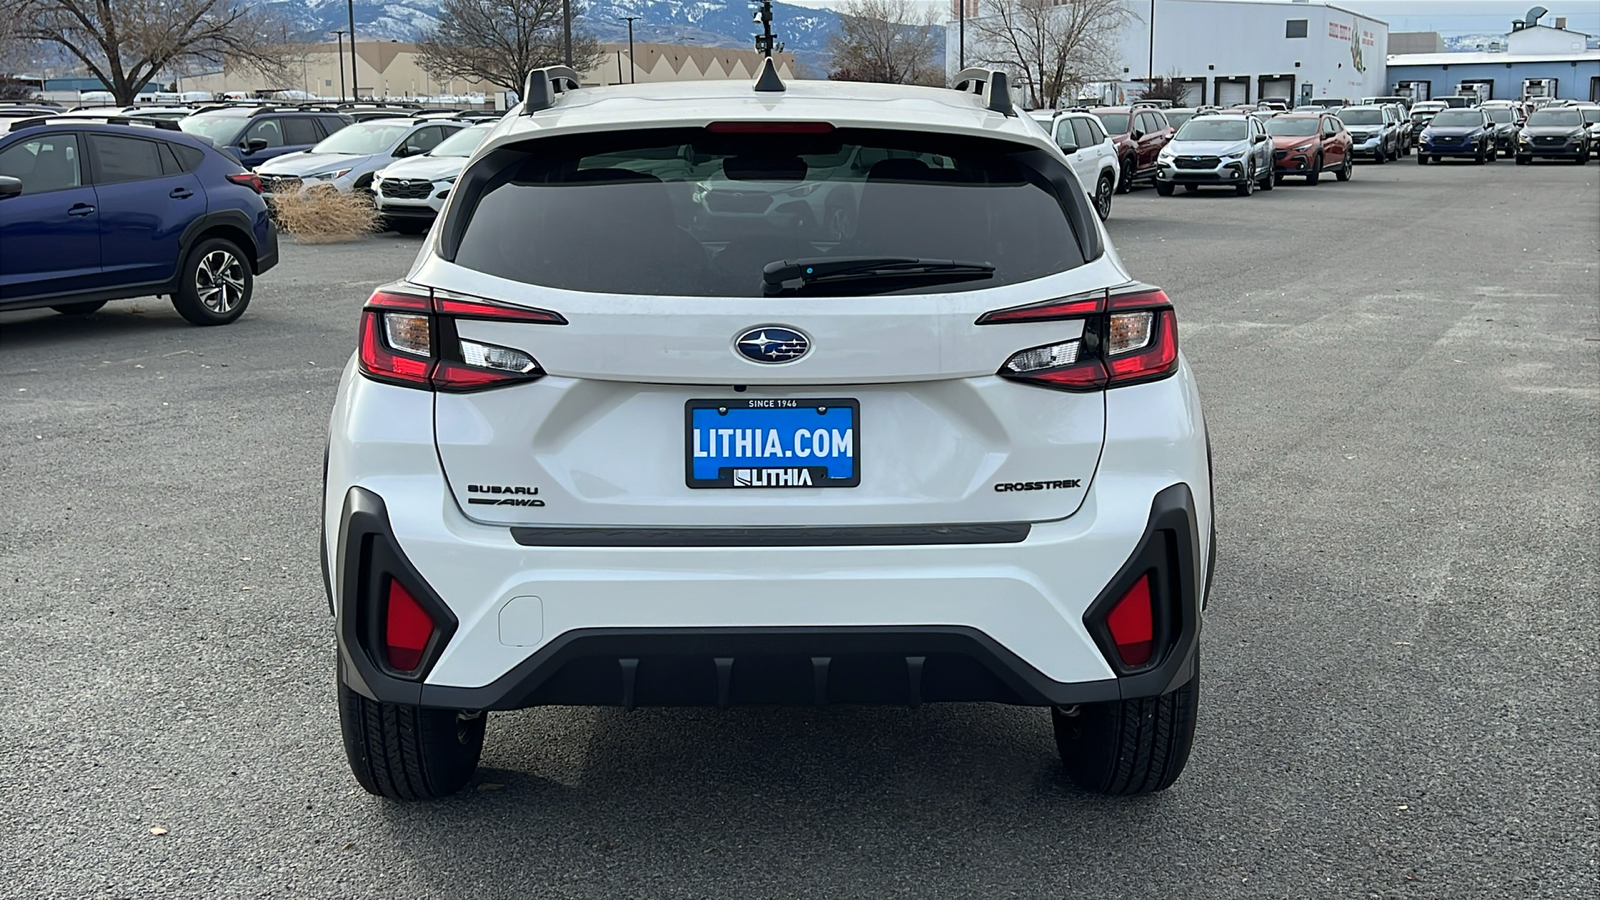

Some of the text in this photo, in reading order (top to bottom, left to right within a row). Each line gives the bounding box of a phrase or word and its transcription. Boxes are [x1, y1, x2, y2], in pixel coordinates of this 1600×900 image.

[749, 400, 797, 408] SINCE 1946
[693, 428, 853, 458] LITHIA.COM
[751, 468, 813, 486] LITHIA
[467, 484, 539, 495] SUBARU
[994, 478, 1081, 493] CROSSTREK
[495, 498, 546, 507] AWD
